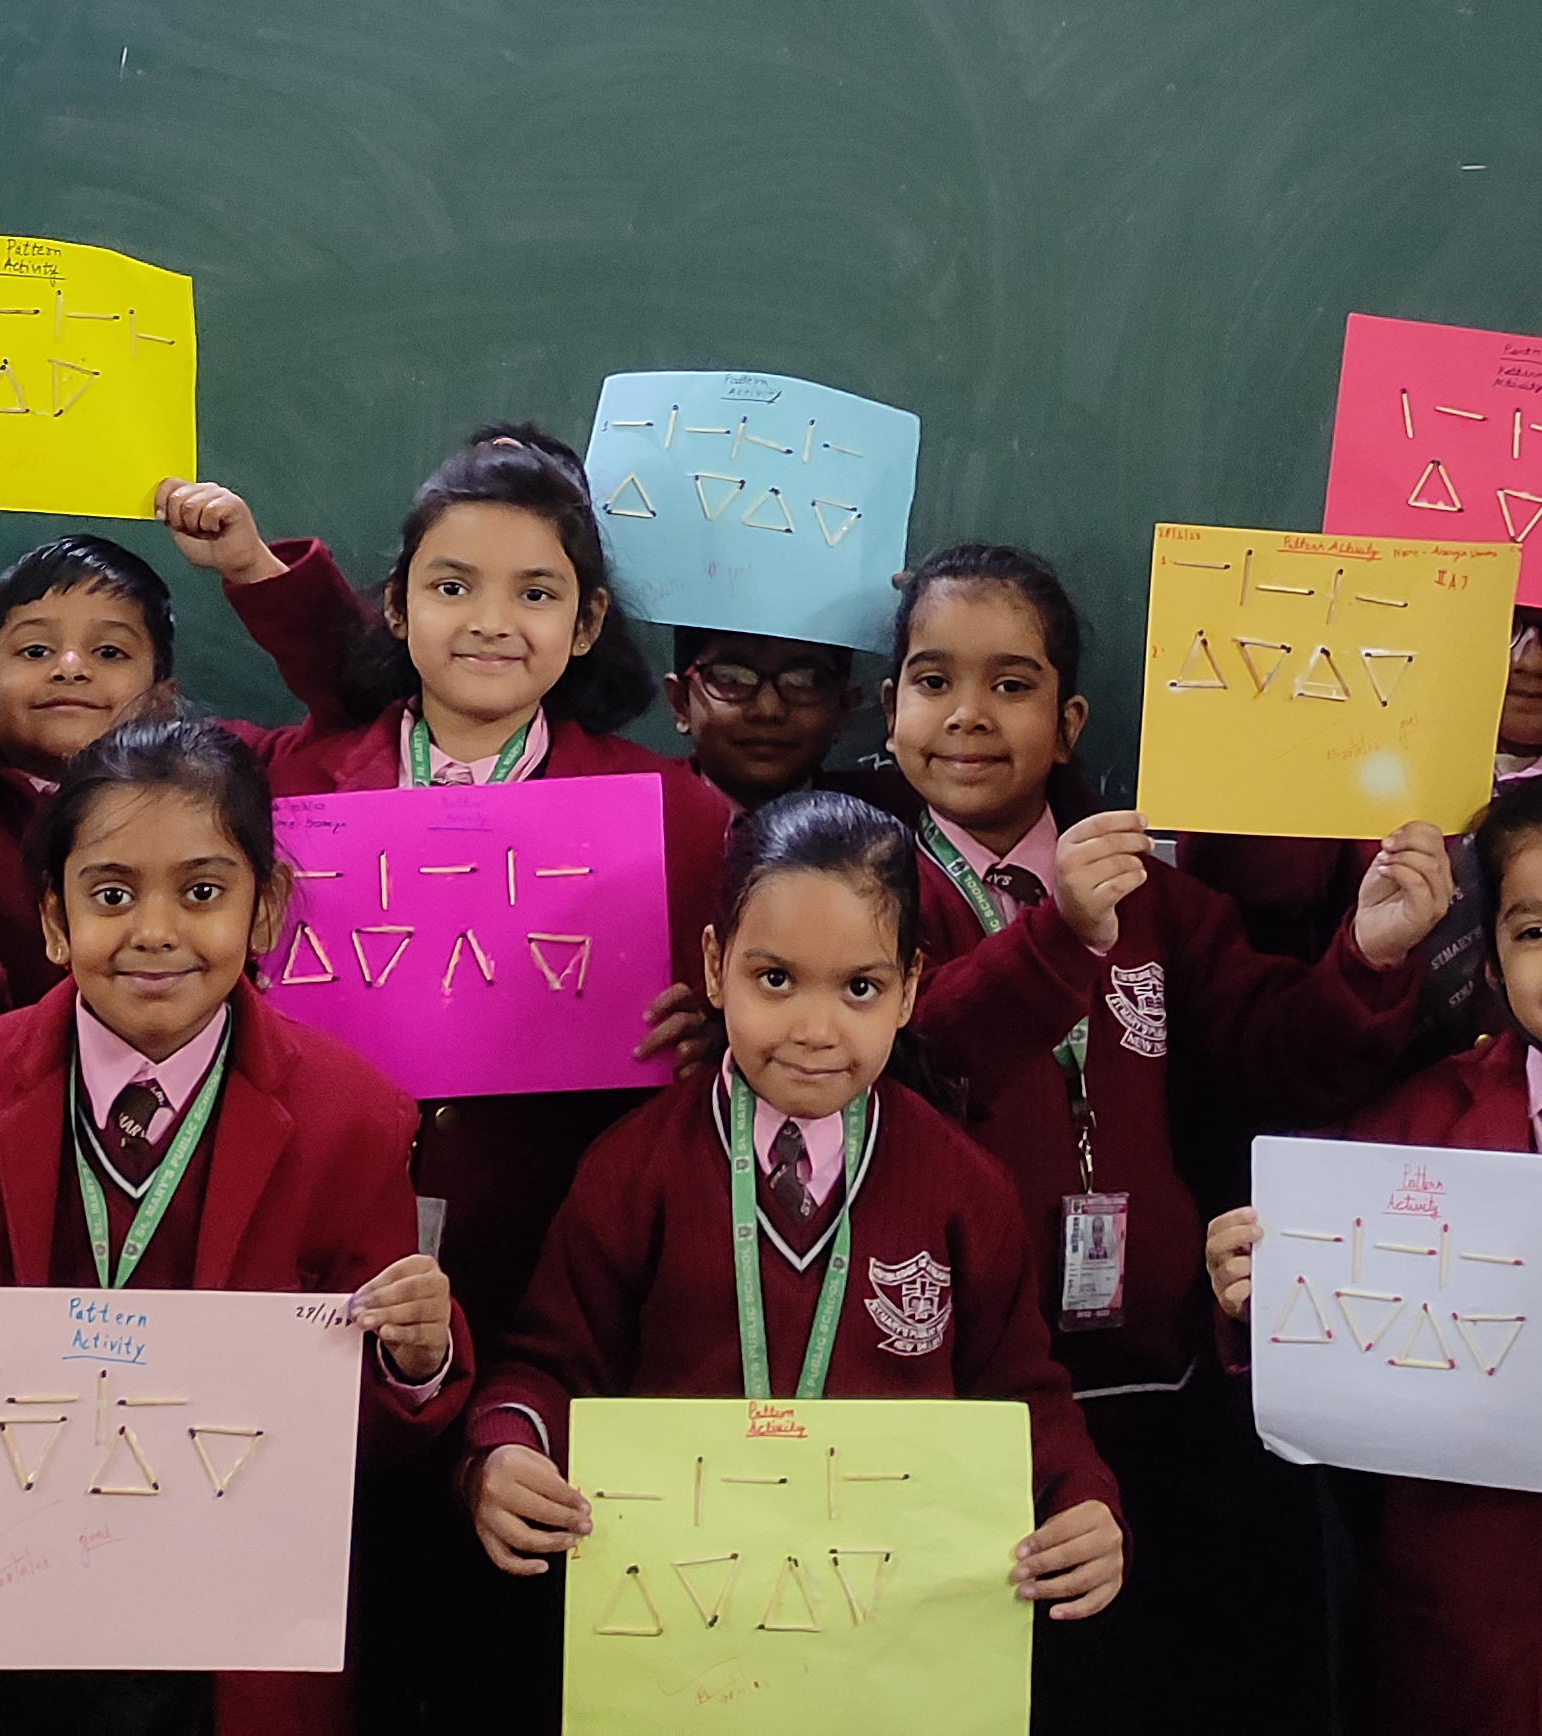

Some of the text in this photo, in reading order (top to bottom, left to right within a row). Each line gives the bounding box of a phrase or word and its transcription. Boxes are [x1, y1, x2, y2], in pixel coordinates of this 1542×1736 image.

[7, 238, 62, 257] Pattern
[3, 257, 61, 288] Activity
[964, 874, 995, 918] SCHOOL
[144, 1168, 176, 1217] MARY'S
[170, 1120, 198, 1167] PUBLIC
[193, 1073, 220, 1122] SCHOOL
[68, 1296, 149, 1328] Pattern
[71, 1328, 147, 1363] Activity
[806, 1278, 840, 1387] PUBLIC SCHOOL
